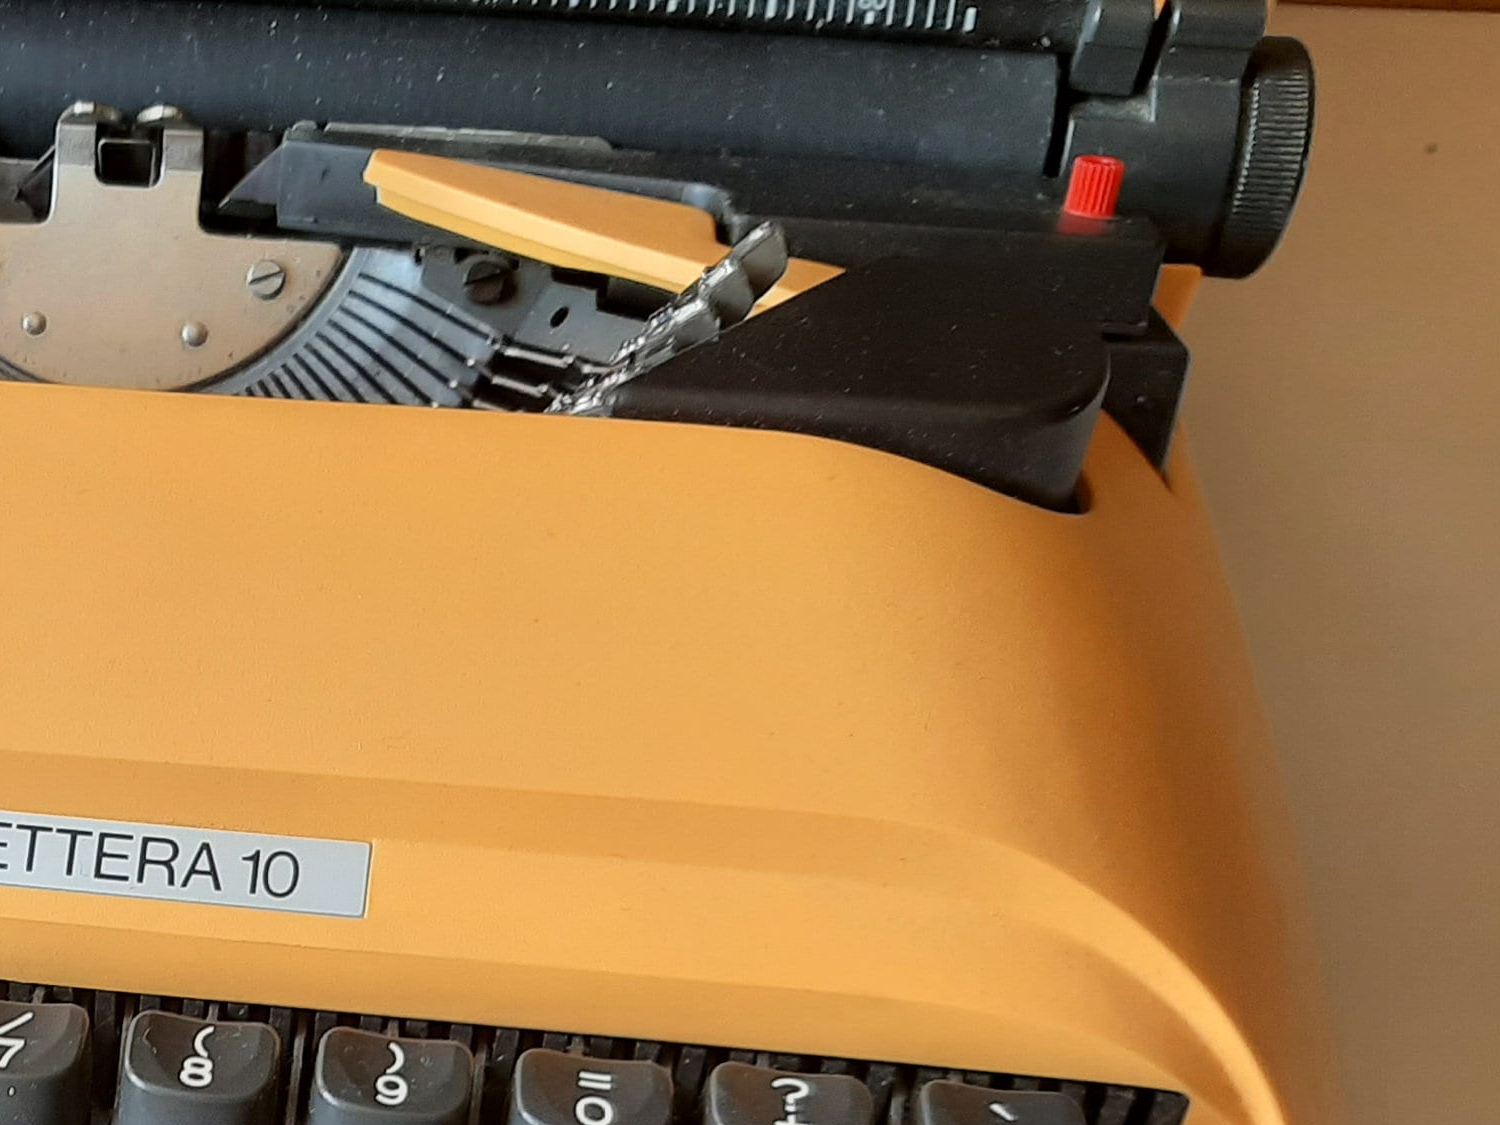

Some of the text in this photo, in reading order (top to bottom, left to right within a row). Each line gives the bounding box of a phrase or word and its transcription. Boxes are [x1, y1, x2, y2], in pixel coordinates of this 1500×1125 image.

[242, 848, 300, 898] 10
[179, 1056, 214, 1088] 8
[375, 1075, 409, 1106] 9
[770, 1077, 810, 1113] ?
